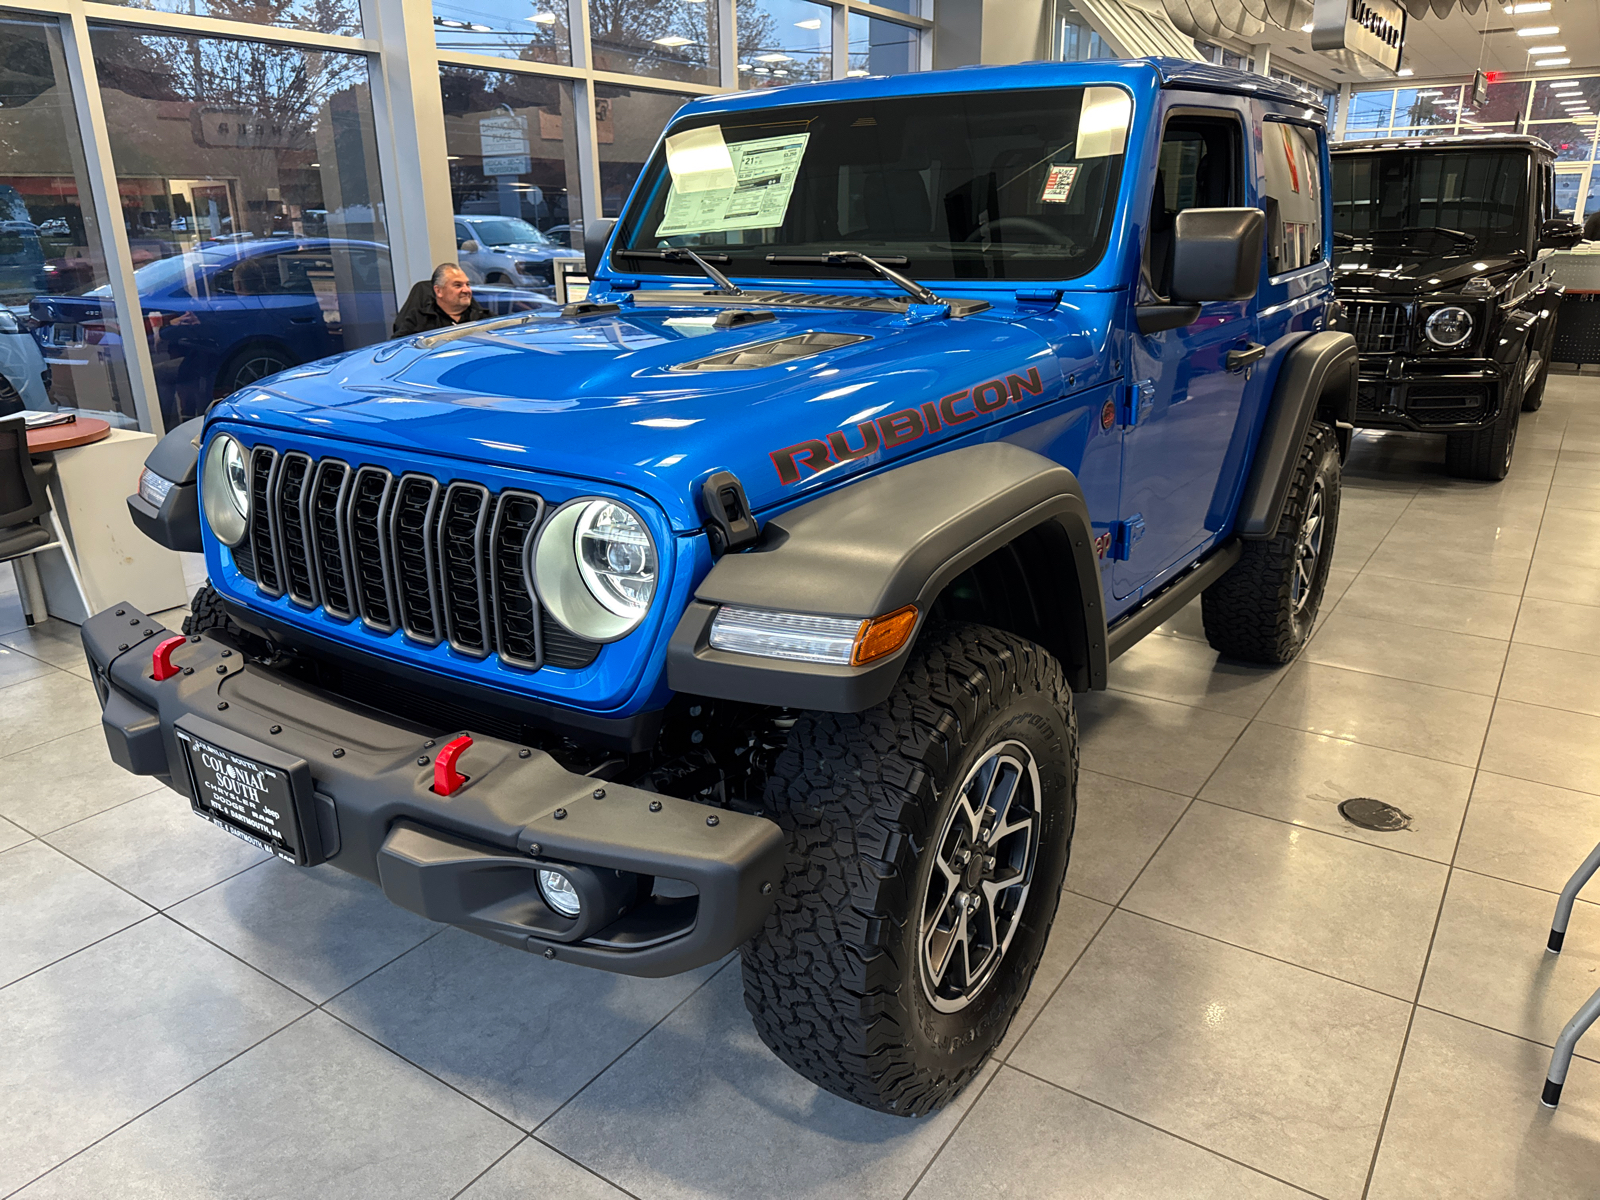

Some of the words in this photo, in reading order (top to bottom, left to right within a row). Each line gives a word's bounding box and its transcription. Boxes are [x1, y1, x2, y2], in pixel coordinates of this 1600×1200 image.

[492, 132, 512, 142] PLACE
[744, 157, 755, 165] 21
[769, 366, 1044, 486] RUBICON
[1094, 532, 1112, 560] ep
[201, 752, 269, 793] COLONIAL
[204, 780, 257, 809] CHRYSLER
[262, 805, 280, 820] Jeep
[215, 772, 260, 803] SOUTH
[212, 792, 246, 813] DODGE
[271, 828, 283, 839] MA
